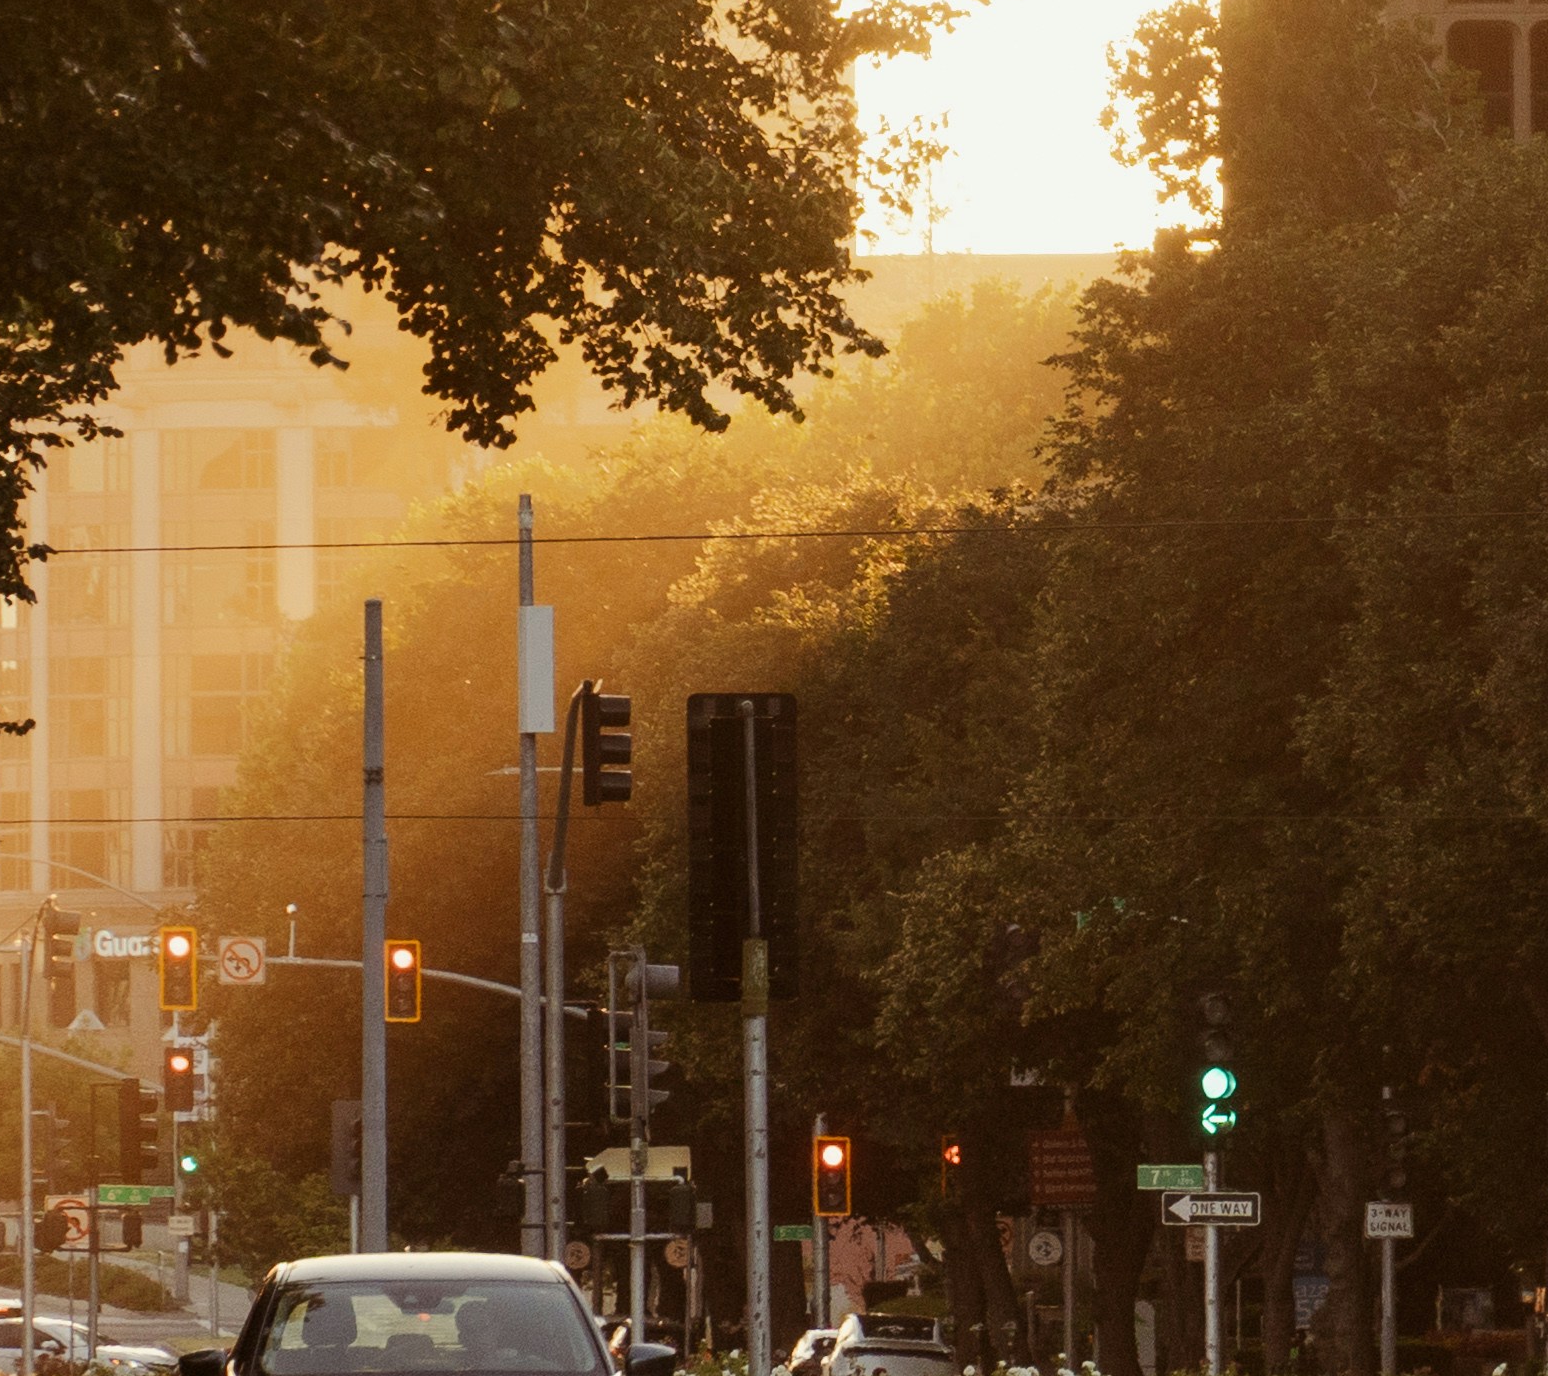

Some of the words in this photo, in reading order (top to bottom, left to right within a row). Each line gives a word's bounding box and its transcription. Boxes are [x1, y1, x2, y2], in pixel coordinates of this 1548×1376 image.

[1190, 1202, 1217, 1215] ONE
[1219, 1202, 1249, 1215] WAY
[1370, 1208, 1407, 1219] 3-WAY
[1369, 1221, 1410, 1233] SIGNAL
